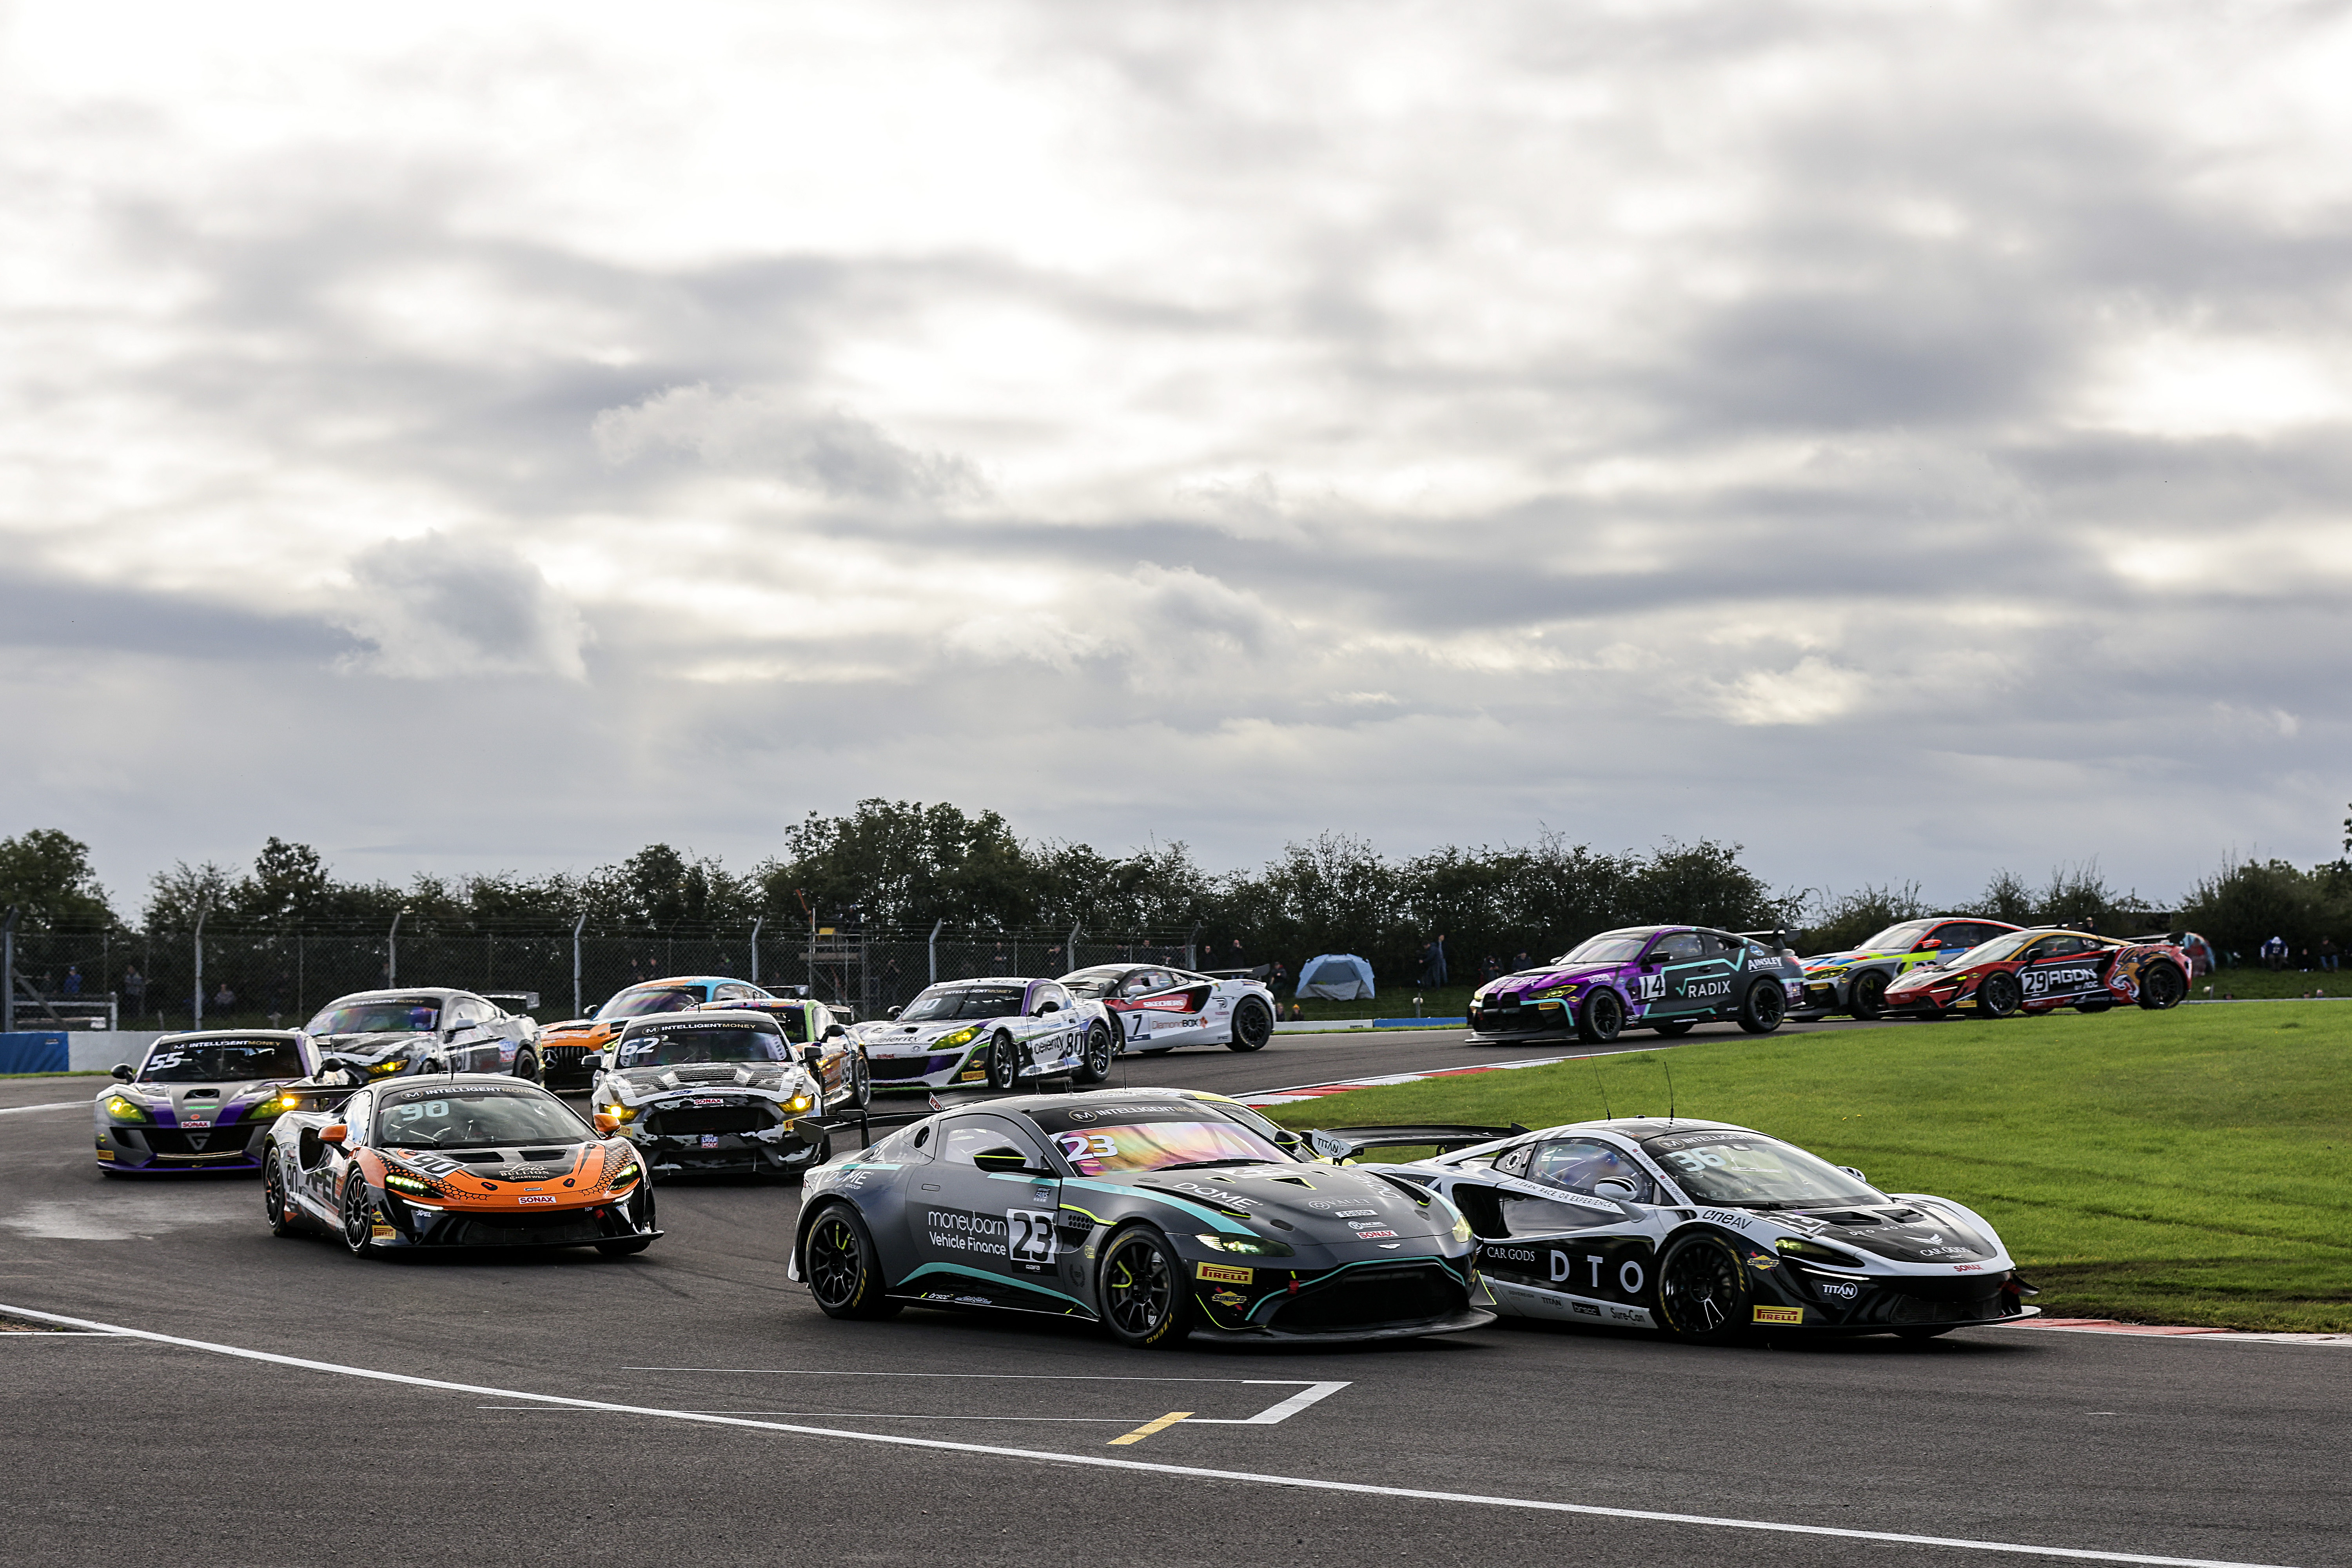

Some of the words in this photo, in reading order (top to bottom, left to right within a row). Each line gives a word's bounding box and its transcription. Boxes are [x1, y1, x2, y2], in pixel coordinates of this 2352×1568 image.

[1748, 957, 1782, 970] AINSLEY
[2025, 974, 2045, 993] 29
[2049, 969, 2097, 984] AGON
[1644, 975, 1664, 998] 14
[1688, 980, 1731, 998] RADIX
[1133, 1014, 1143, 1036] 7
[620, 1038, 660, 1056] 62
[1066, 1033, 1082, 1057] 80
[146, 1052, 185, 1071] 55
[401, 1100, 450, 1121] 90
[1060, 1135, 1118, 1162] 23
[1318, 1137, 1339, 1153] TITAN
[404, 1155, 464, 1174] 90
[1667, 1147, 1726, 1172] 36
[287, 1163, 298, 1193] 90
[824, 1171, 871, 1185] DOME
[1172, 1182, 1259, 1208] DOME
[1216, 1201, 1243, 1210] GROUP
[928, 1210, 1007, 1236] moneybarn
[929, 1231, 965, 1249] Vehicle
[967, 1236, 1007, 1256] Finance
[1013, 1212, 1053, 1262] 23
[1487, 1247, 1506, 1259] CAR
[1508, 1249, 1535, 1261] GODS
[1202, 1266, 1249, 1281] PIRELLI
[1822, 1284, 1855, 1295] TITAN
[1541, 1296, 1562, 1306] TITAN
[1757, 1308, 1798, 1321] PIRELLI
[1146, 1321, 1169, 1344] ZERO
